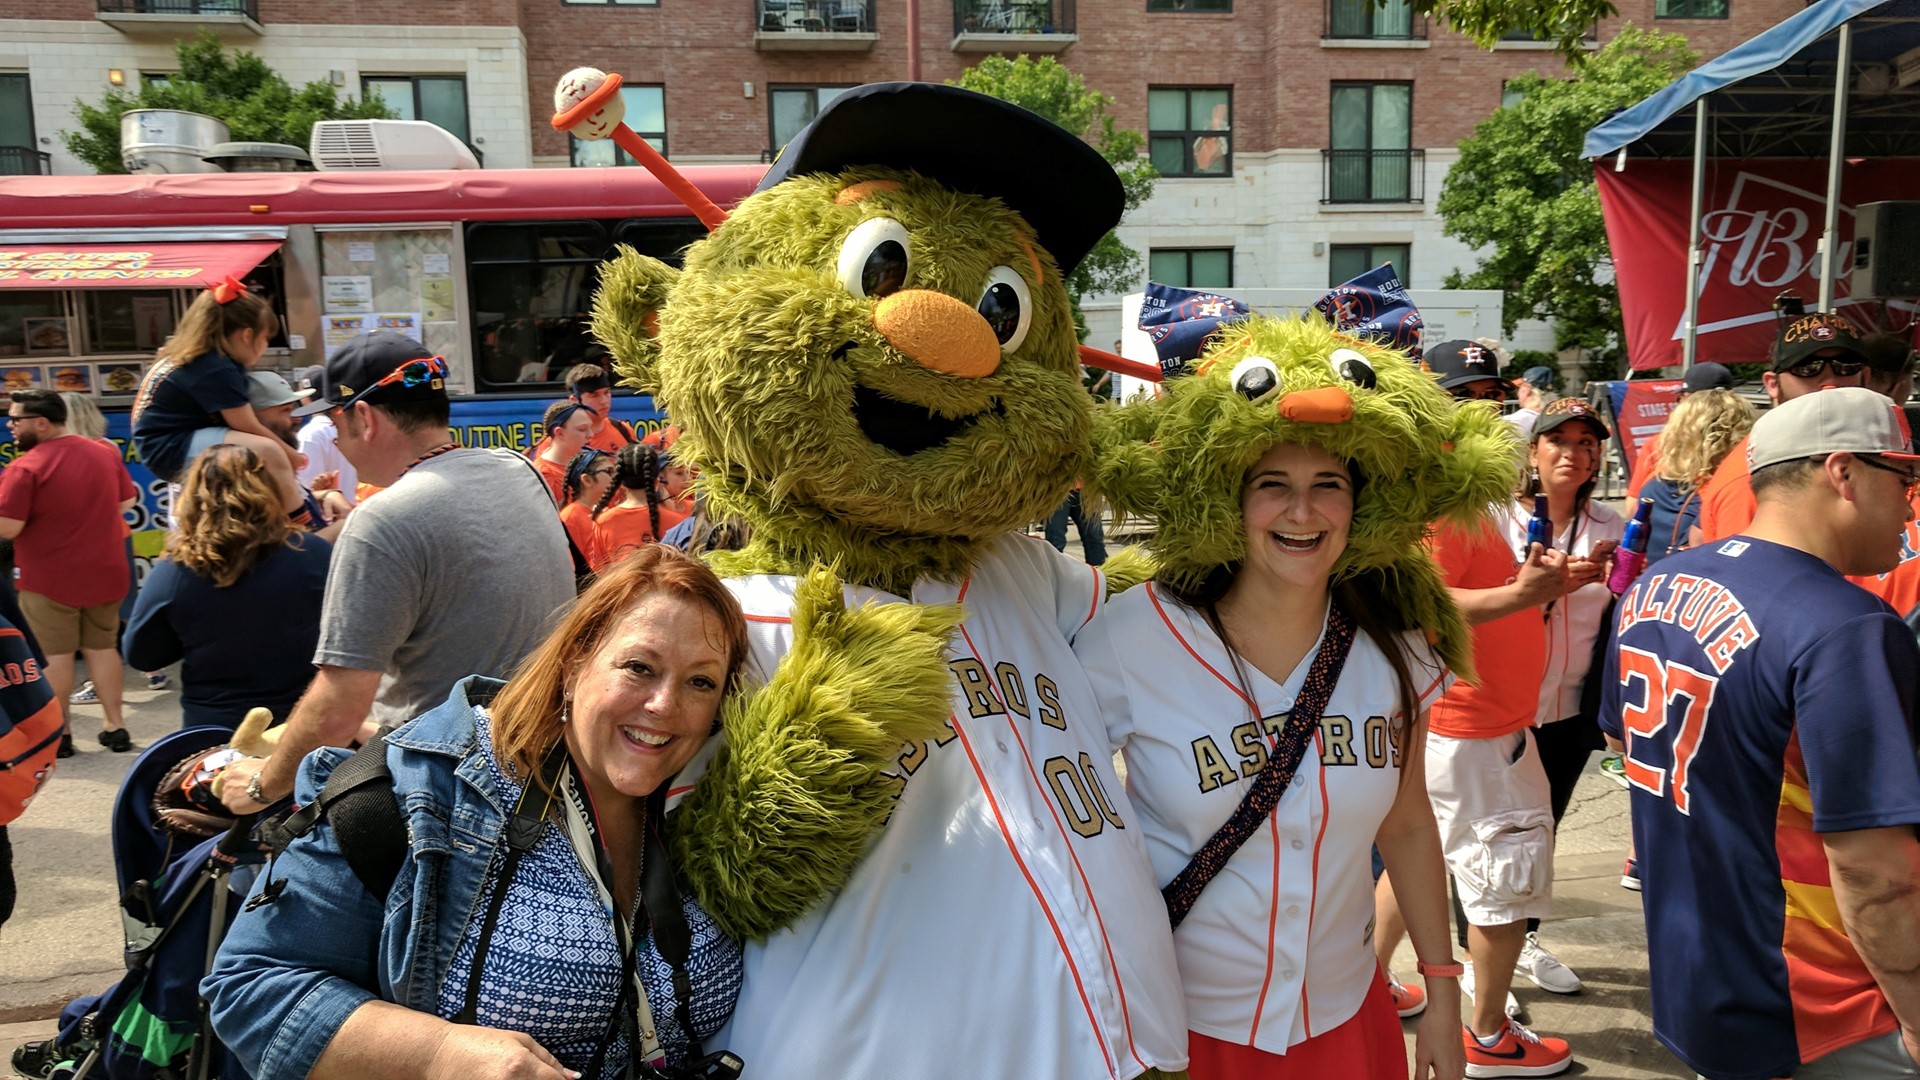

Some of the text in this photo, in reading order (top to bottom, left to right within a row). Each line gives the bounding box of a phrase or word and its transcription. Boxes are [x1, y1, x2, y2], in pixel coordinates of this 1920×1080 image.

[448, 423, 526, 451] OUTINE
[1638, 403, 1668, 418] STAGE
[1618, 573, 1760, 676] ALTUVE
[1619, 644, 1719, 817] 27
